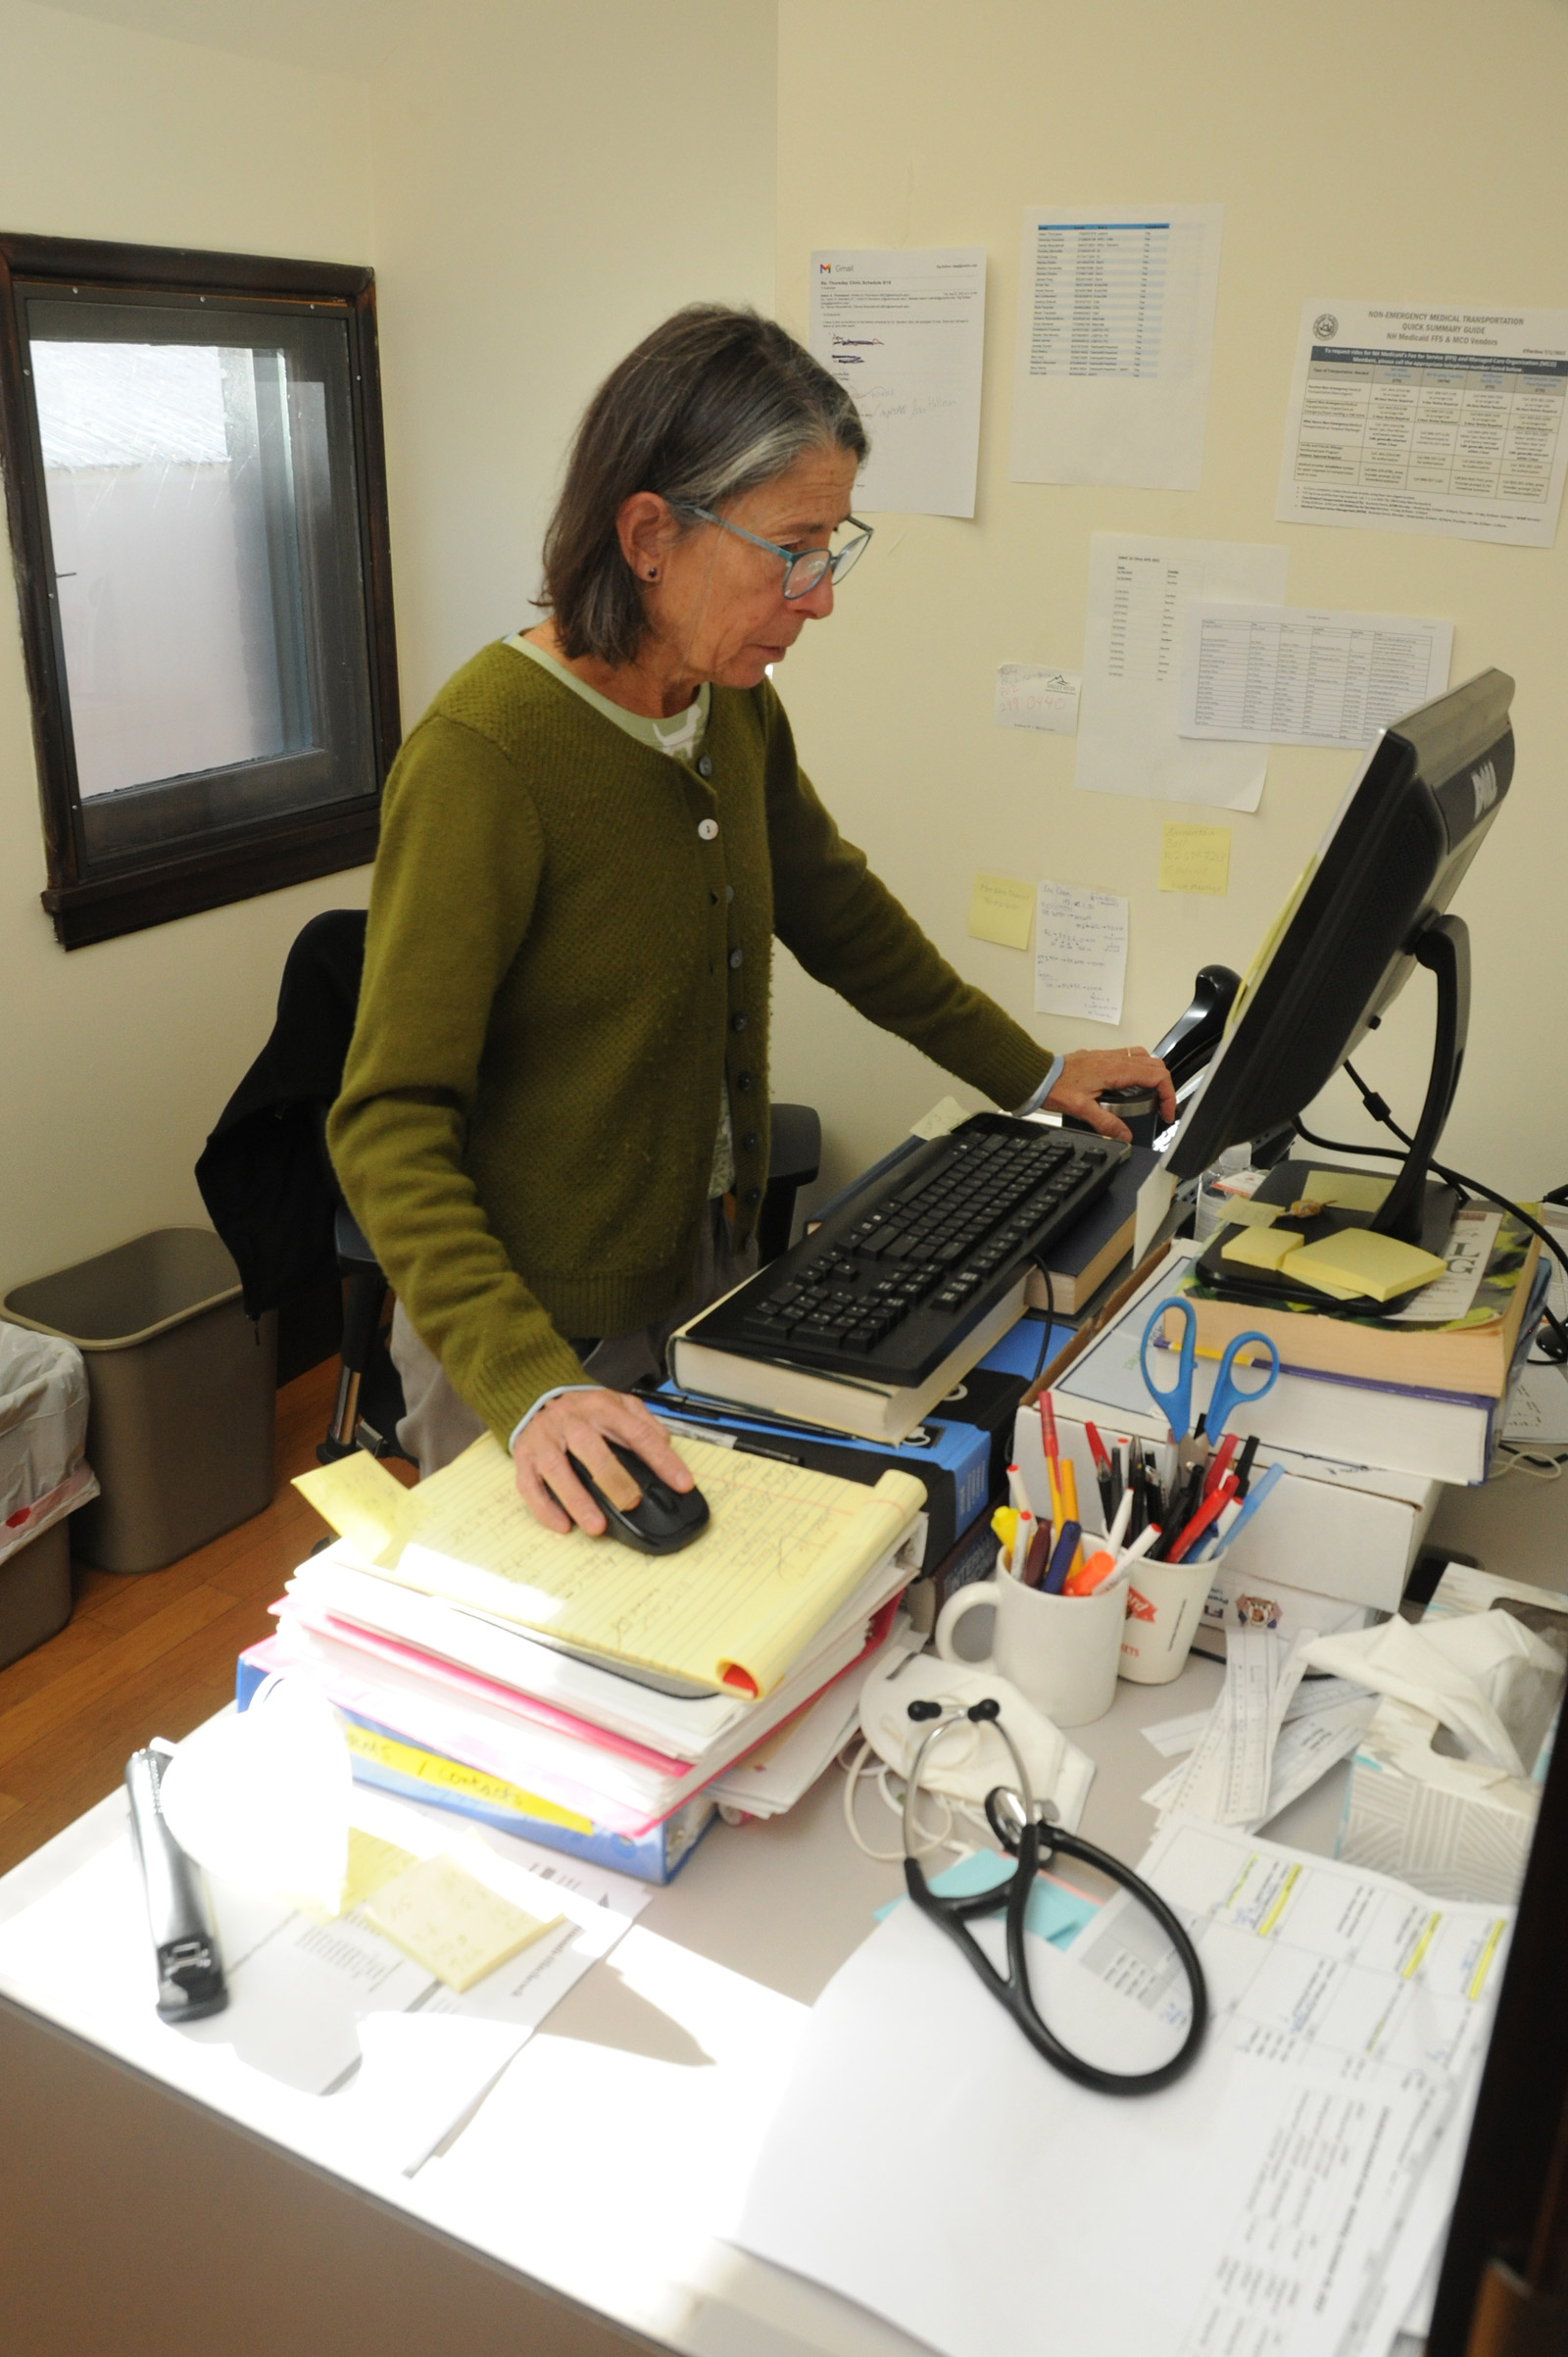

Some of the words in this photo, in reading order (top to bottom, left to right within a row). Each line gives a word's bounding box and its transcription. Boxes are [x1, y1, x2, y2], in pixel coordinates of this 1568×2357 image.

[1368, 311, 1428, 320] NON-EMERGENCY
[1429, 314, 1460, 322] MEDICAL
[1463, 315, 1524, 325] TRANSPORTATION
[1402, 322, 1424, 331] QUICK
[1426, 324, 1461, 333] SUMMARY
[1398, 333, 1430, 342] Medicaid
